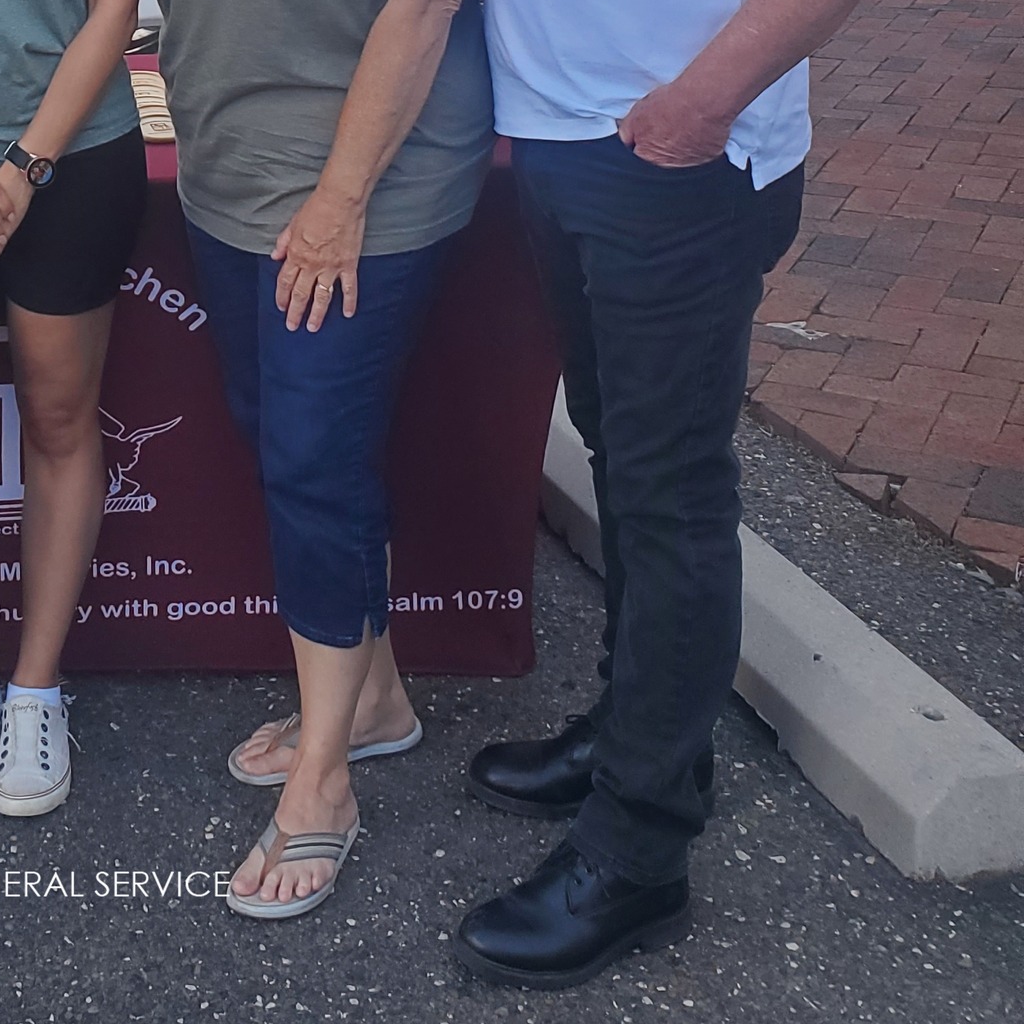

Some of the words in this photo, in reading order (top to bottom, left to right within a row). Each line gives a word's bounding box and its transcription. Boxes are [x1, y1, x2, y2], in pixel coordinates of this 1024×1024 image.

[119, 266, 207, 332] chen
[145, 555, 193, 576] Inc.
[100, 598, 158, 619] with
[166, 596, 236, 621] good
[387, 592, 444, 613] salm
[451, 588, 524, 611] 107:9
